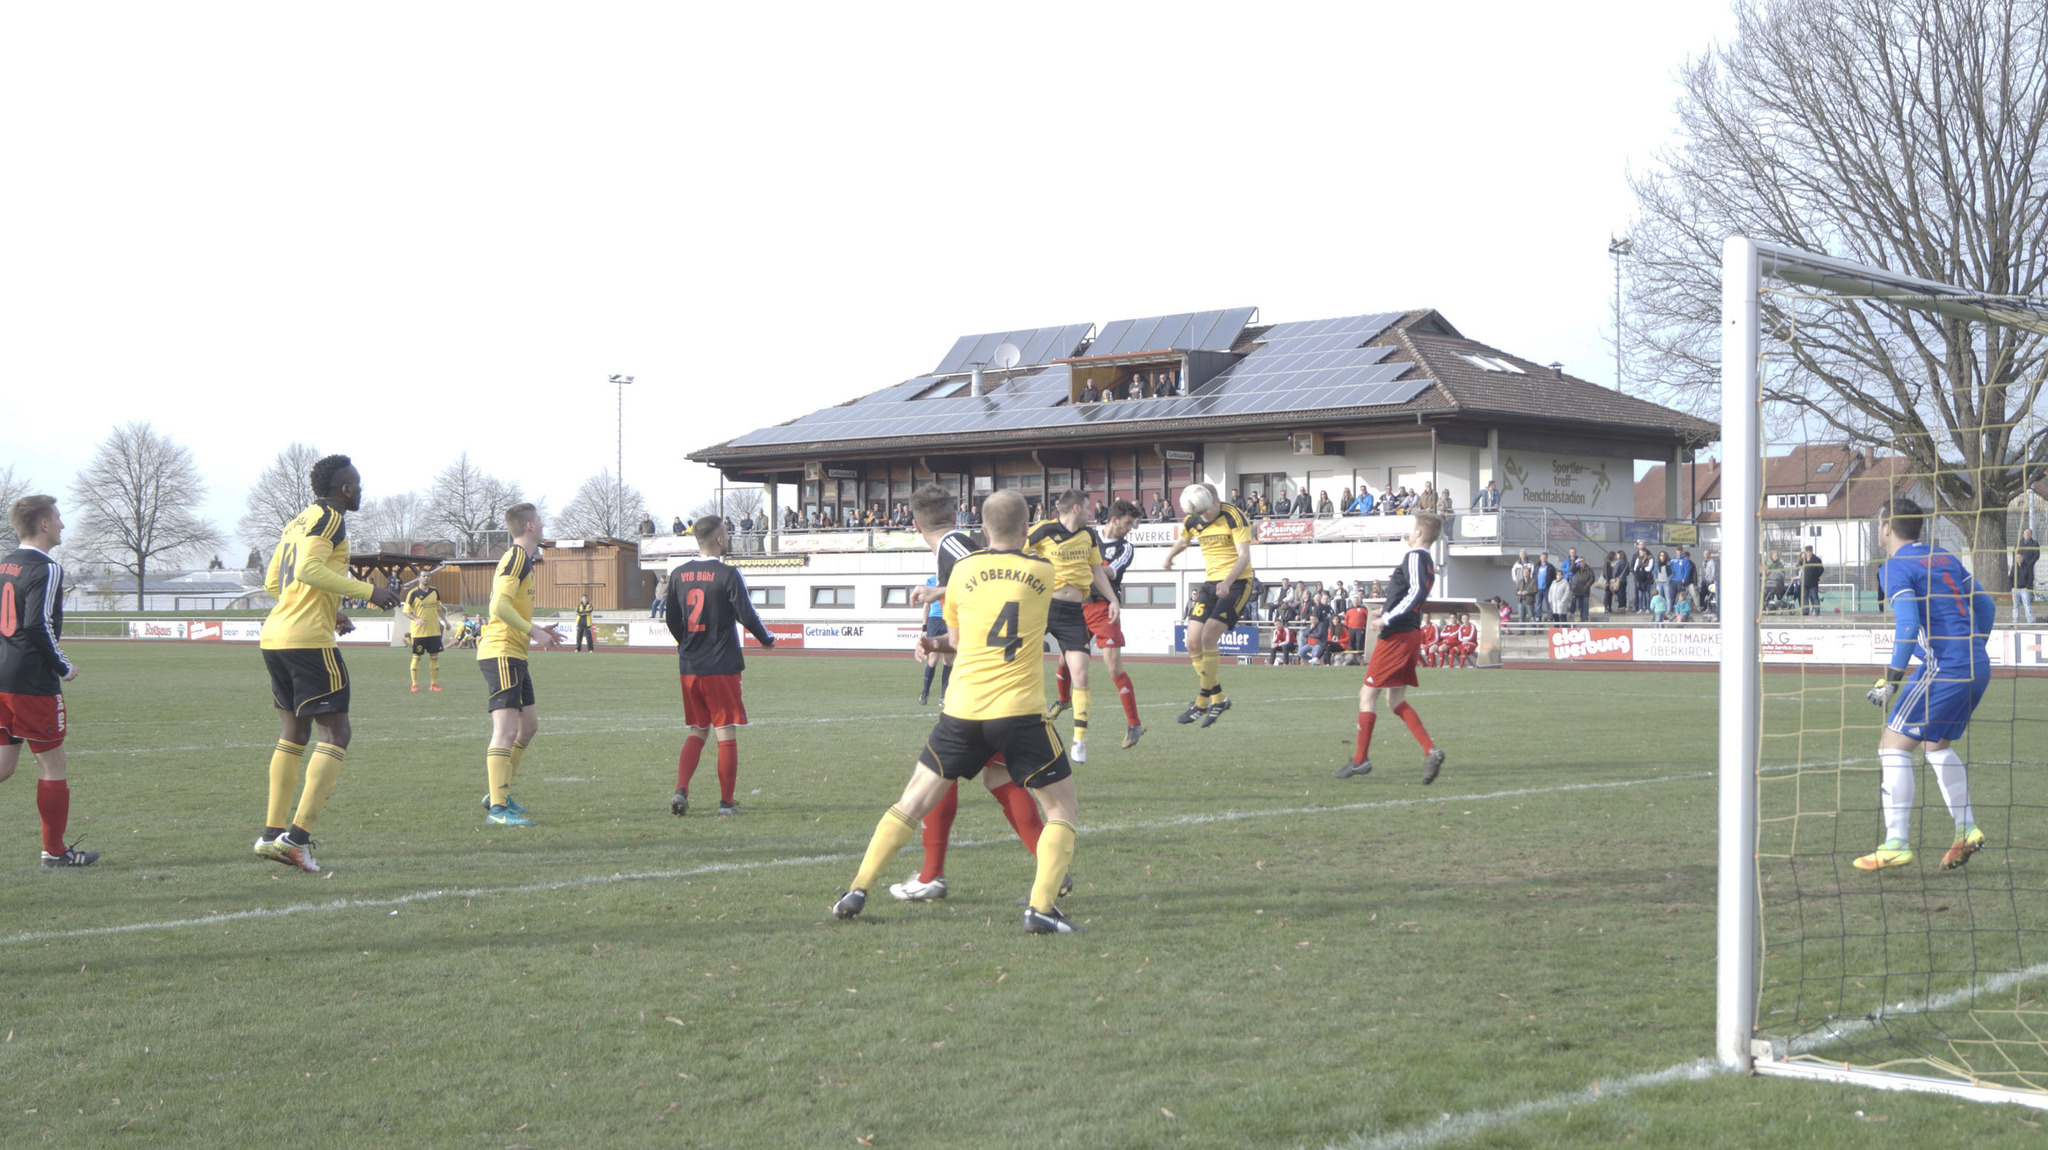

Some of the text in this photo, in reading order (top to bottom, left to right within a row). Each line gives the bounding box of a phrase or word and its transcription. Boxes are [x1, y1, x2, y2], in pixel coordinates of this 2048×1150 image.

[1522, 487, 1585, 504] Renchtalstadion
[680, 570, 715, 583] VfB Bühl
[965, 568, 1046, 595] SV OBERKIRCH
[686, 588, 706, 632] 2
[1191, 602, 1206, 616] 16
[841, 626, 865, 637] GRAF
[986, 601, 1023, 662] 4
